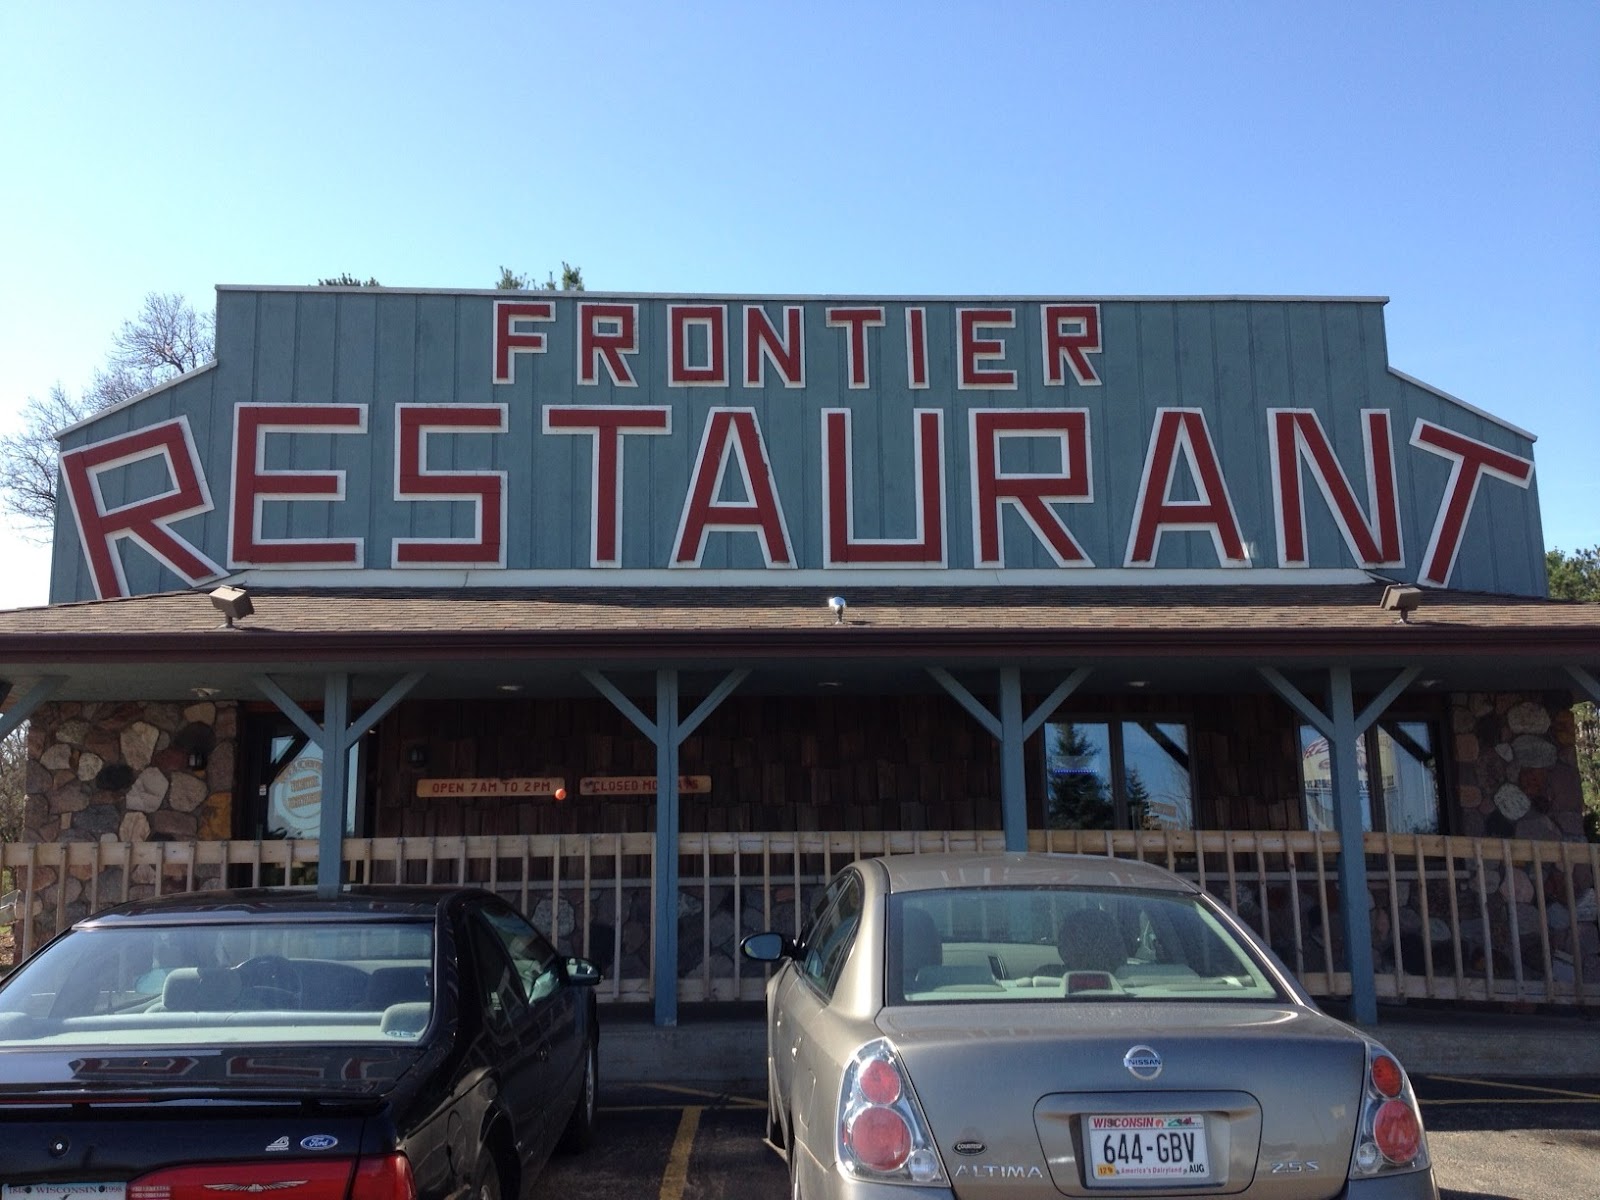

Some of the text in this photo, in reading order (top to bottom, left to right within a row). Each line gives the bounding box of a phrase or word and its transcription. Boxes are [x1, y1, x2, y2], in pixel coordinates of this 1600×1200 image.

[492, 299, 1105, 391] FRONTIER
[58, 401, 1535, 600] RESTAURANT
[432, 781, 551, 793] OPEN 7AM TO 2PM
[592, 778, 699, 792] CLOSED MOYS
[1093, 1117, 1154, 1129] WISCONSIN
[1103, 1132, 1195, 1164] 644-GBV
[955, 1164, 1043, 1179] ALTIMA
[1189, 1163, 1205, 1173] AUG
[36, 1186, 97, 1194] WISCONSIN
